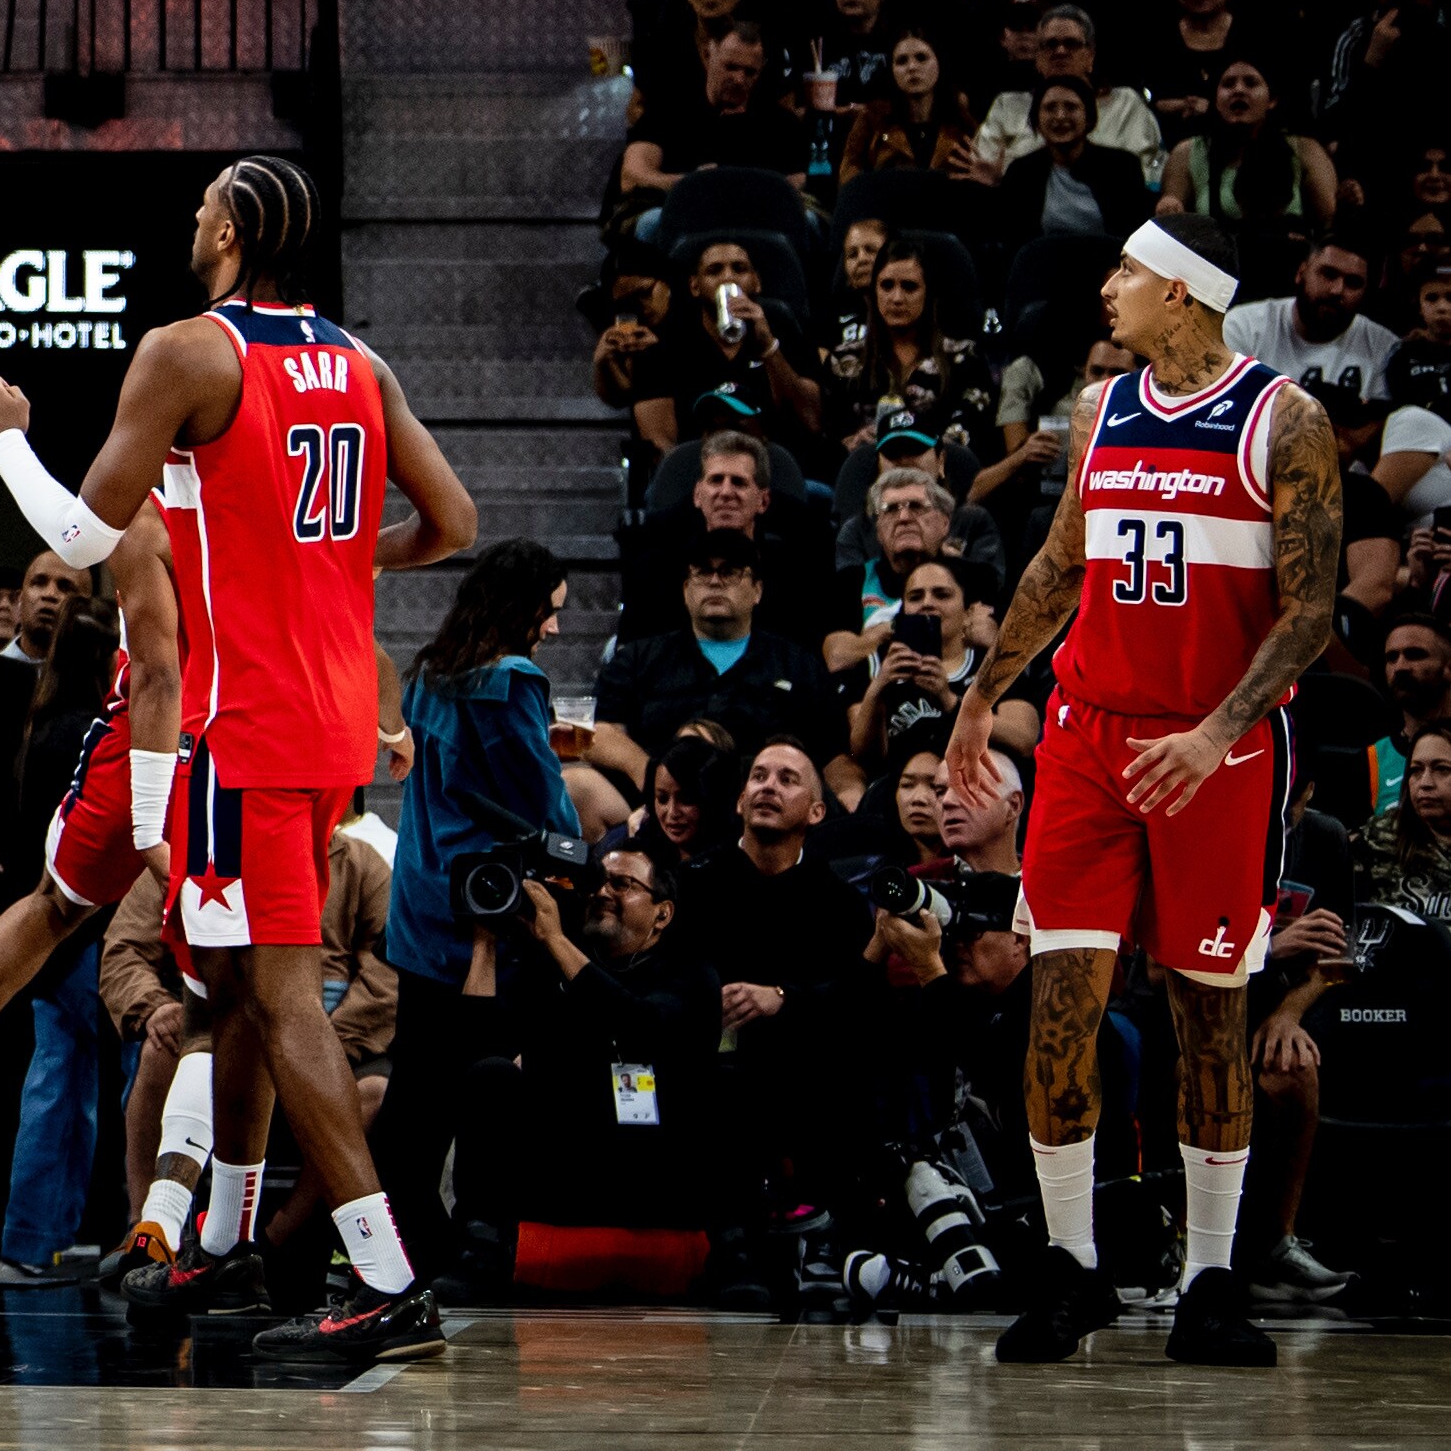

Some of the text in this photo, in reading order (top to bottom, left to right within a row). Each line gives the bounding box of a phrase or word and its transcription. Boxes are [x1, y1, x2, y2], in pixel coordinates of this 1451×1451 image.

[284, 351, 348, 393] SARR
[1195, 420, 1235, 432] Robinhood
[287, 423, 365, 543] 20
[1088, 460, 1226, 500] washington
[1112, 518, 1188, 606] 33
[1198, 924, 1235, 958] dc
[1340, 1008, 1407, 1023] BOOKER
